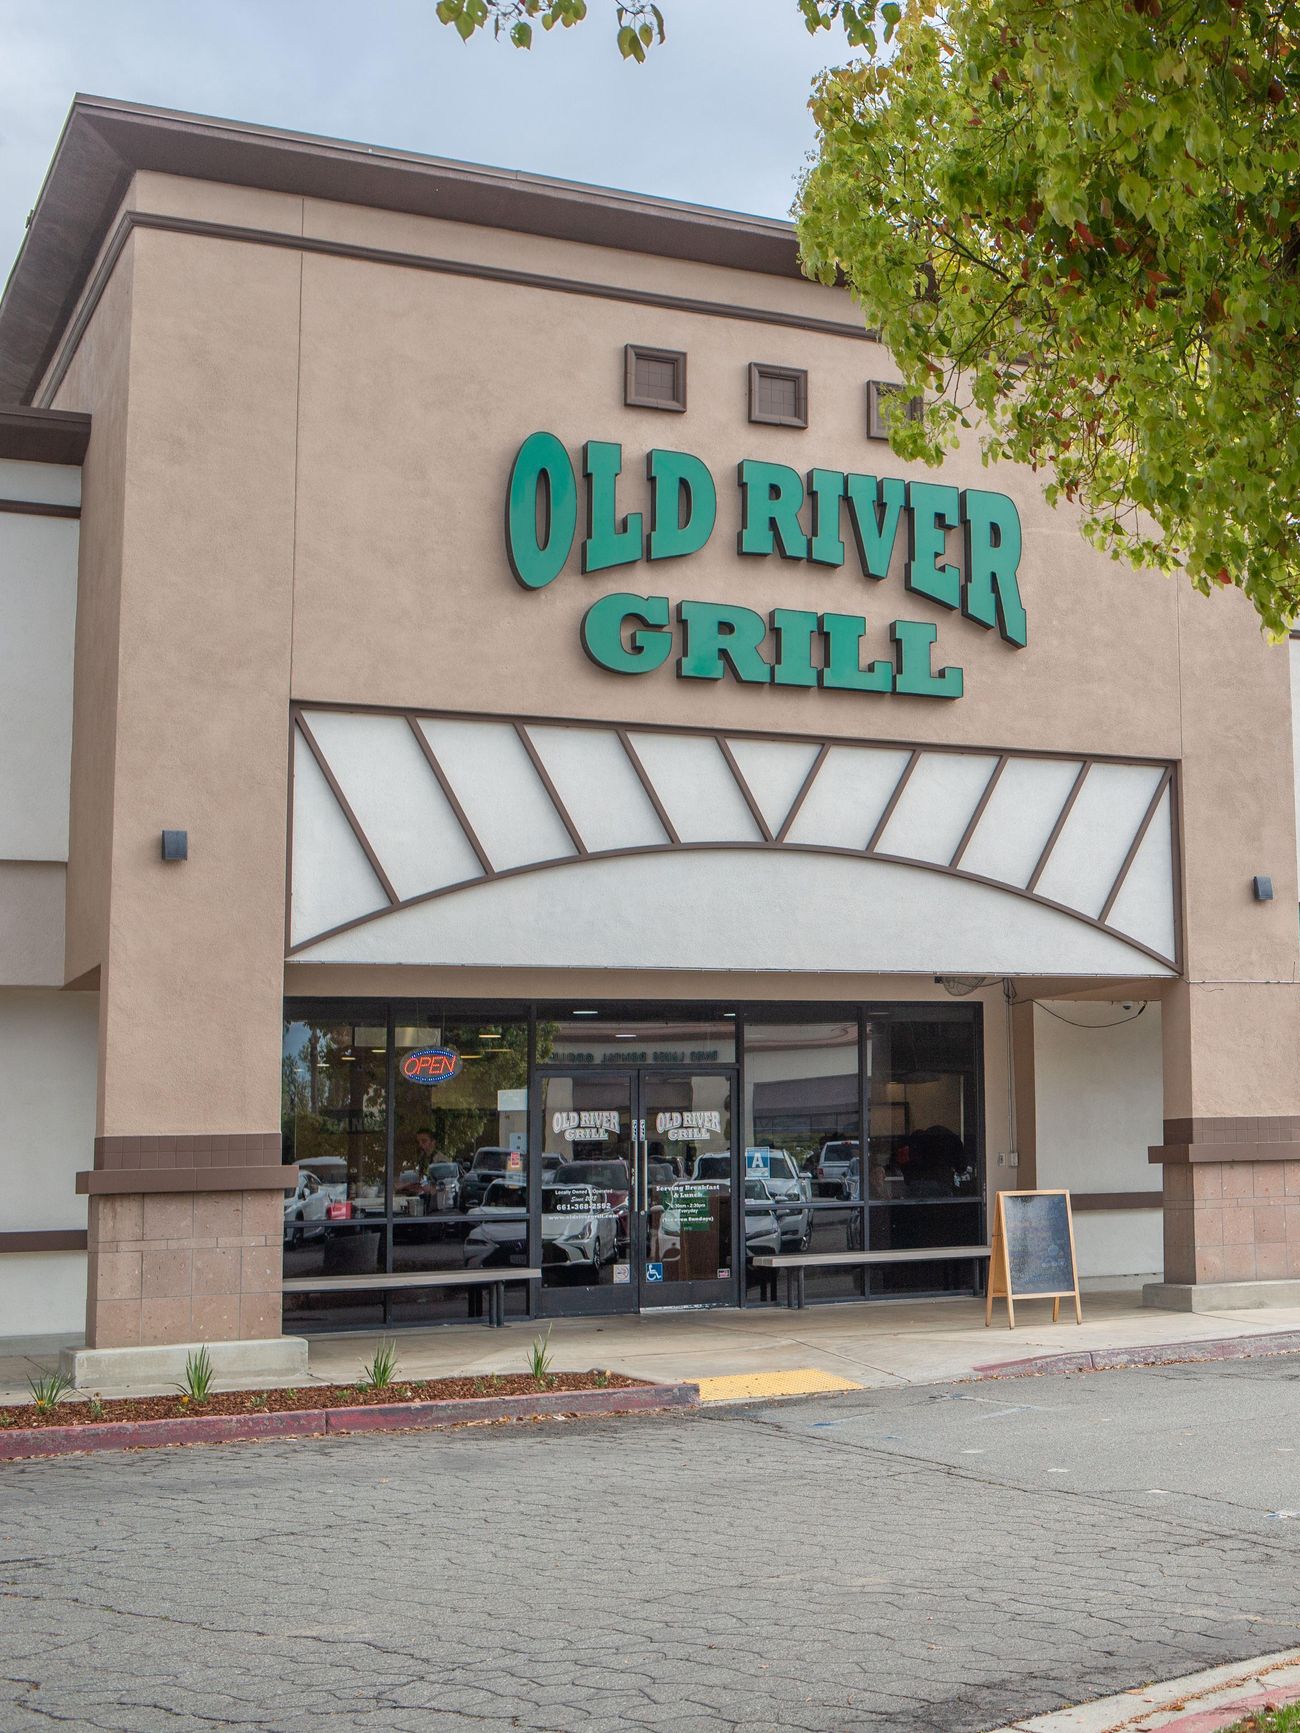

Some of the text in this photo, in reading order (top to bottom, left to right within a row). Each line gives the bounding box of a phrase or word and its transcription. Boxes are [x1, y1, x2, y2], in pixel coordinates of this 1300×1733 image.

[506, 431, 1027, 648] OLD RIVER
[580, 592, 964, 699] GRILL
[404, 1055, 457, 1075] OPEN
[552, 1111, 579, 1133] OLD
[580, 1110, 620, 1133] RIVER
[656, 1111, 682, 1133] OLD
[682, 1110, 720, 1133] RIVER
[564, 1128, 608, 1141] GRILL
[667, 1127, 710, 1141] GRILL
[752, 1152, 764, 1168] A
